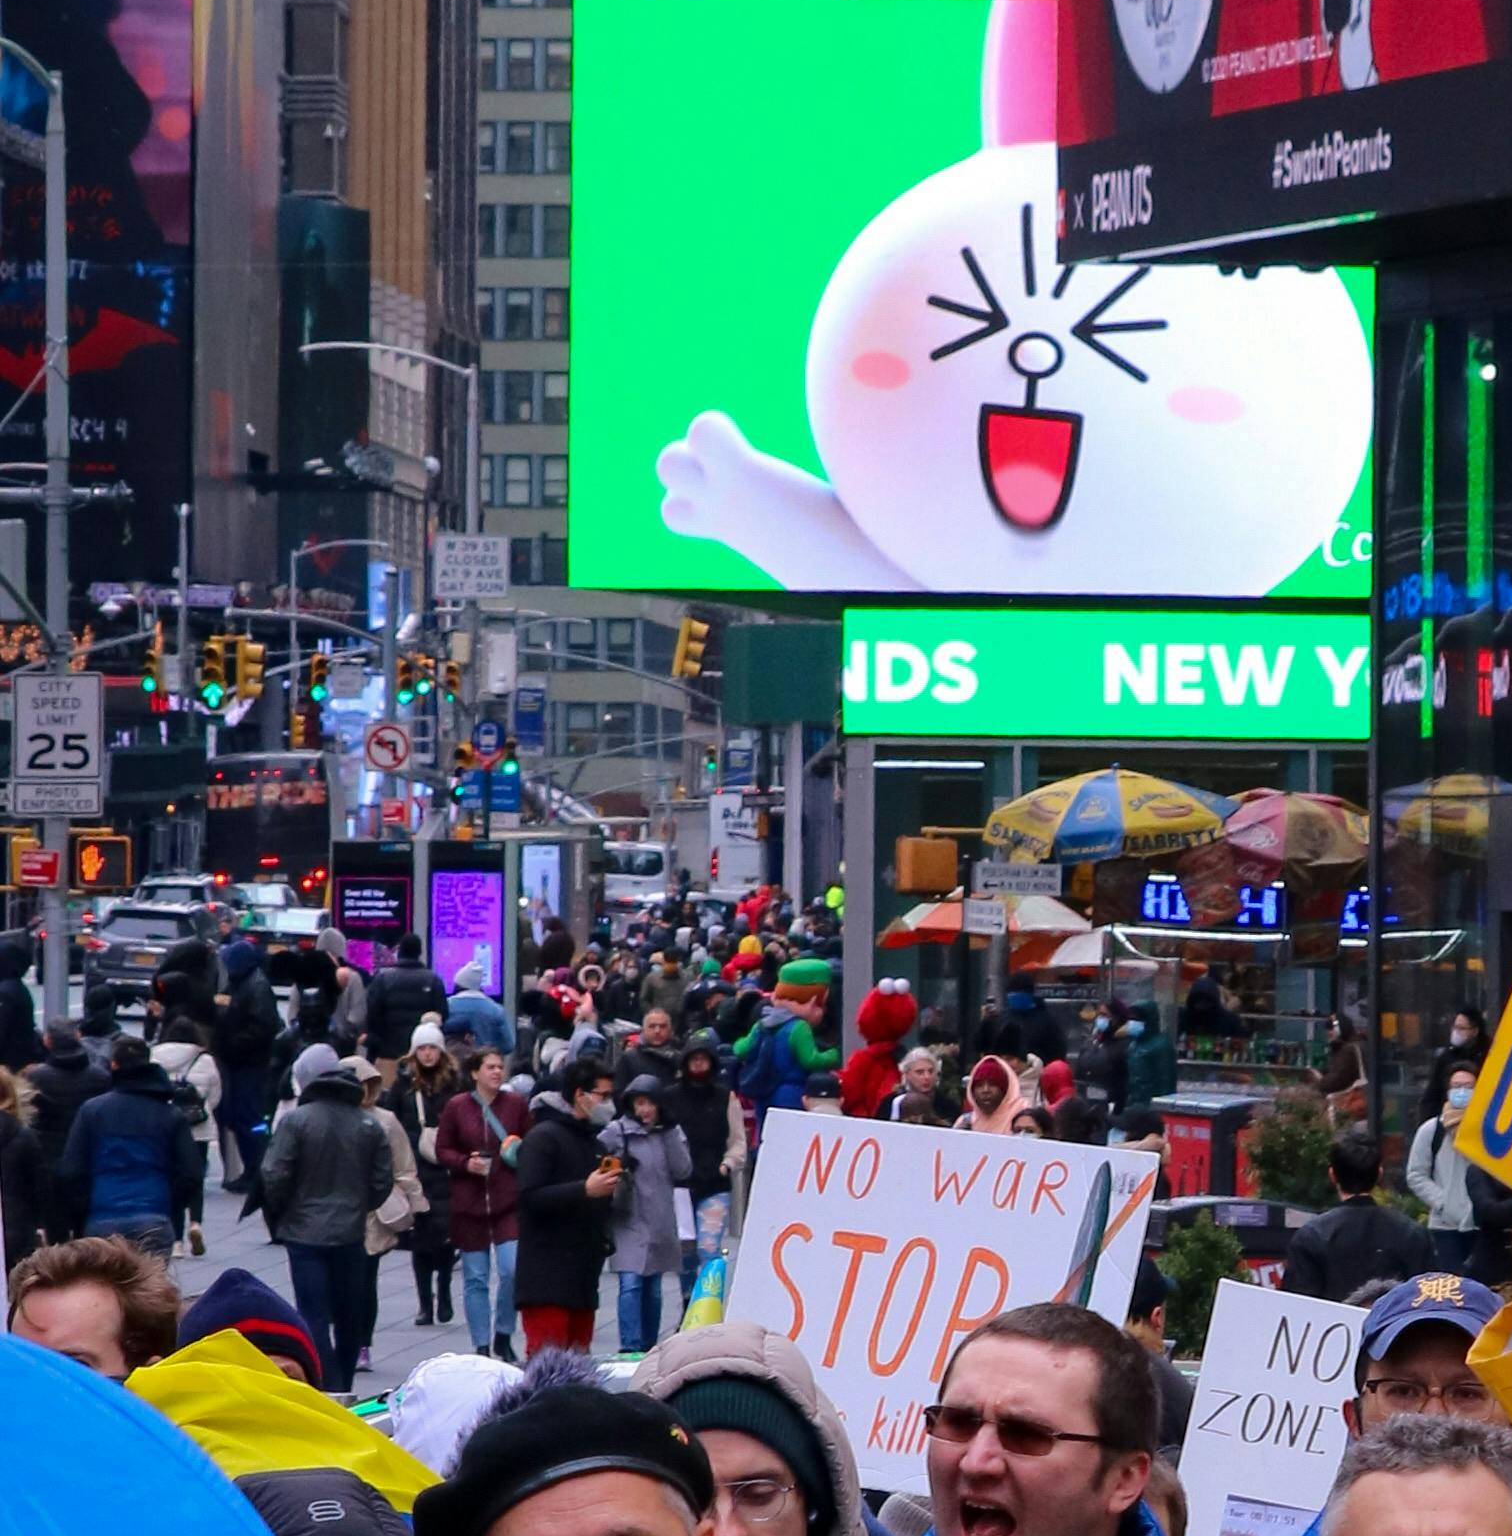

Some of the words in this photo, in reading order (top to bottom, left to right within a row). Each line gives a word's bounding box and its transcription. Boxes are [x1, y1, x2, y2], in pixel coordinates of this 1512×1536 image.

[1272, 126, 1392, 189] #SwatchPeanuts
[1091, 165, 1153, 233] PEANUTS
[31, 697, 81, 710] SPEED
[38, 681, 73, 693] CITY
[1102, 642, 1295, 706] NEW
[1314, 645, 1370, 707] Y
[27, 733, 90, 770] 25
[36, 714, 76, 726] LIMIT
[796, 1133, 882, 1200] NO
[770, 1222, 1010, 1384] STOP
[1266, 1315, 1351, 1383] NO
[1197, 1389, 1340, 1455] ZONE
